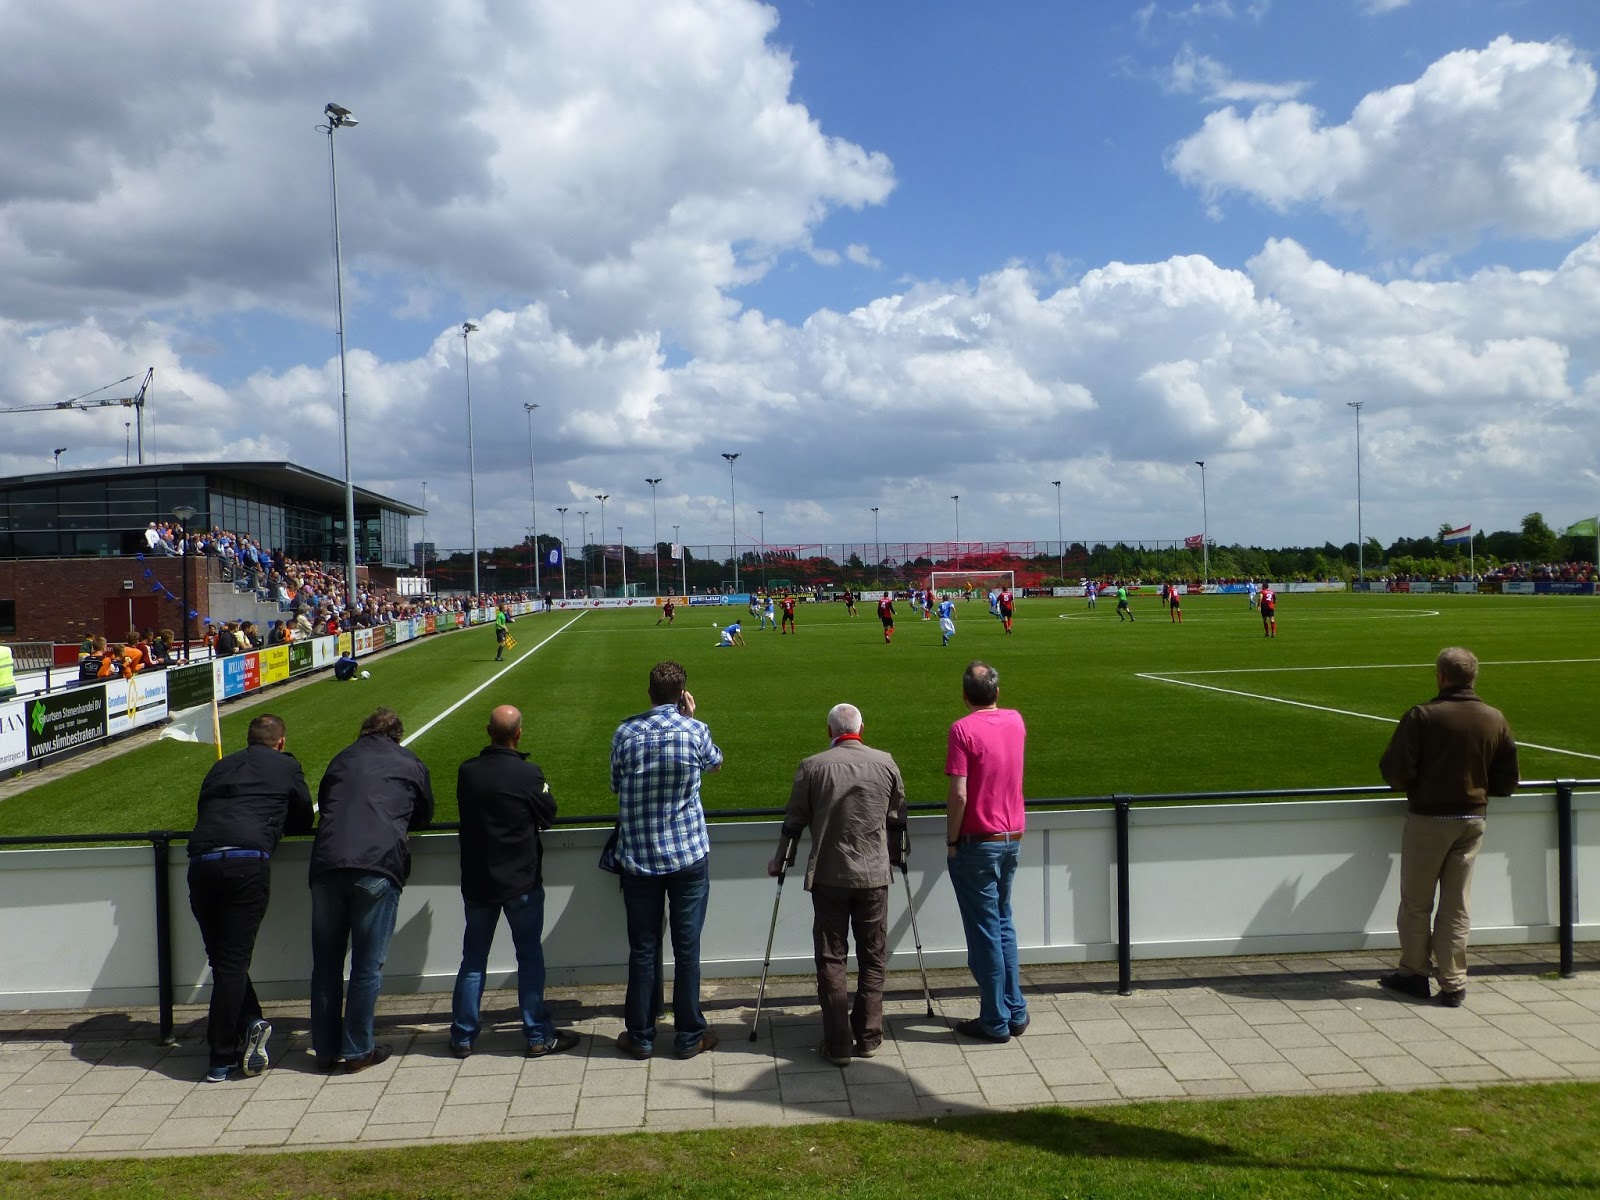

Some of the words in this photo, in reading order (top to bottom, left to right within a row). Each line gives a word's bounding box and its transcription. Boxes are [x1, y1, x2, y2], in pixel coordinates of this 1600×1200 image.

[933, 589, 977, 598] einekn
[1003, 594, 1009, 602] 5
[1266, 593, 1272, 601] 2
[228, 660, 244, 674] HOLLAND
[244, 658, 255, 670] SPORT
[38, 710, 62, 724] Geurtsen
[62, 700, 94, 718] Stenenhandel
[94, 699, 102, 710] BV
[31, 722, 103, 757] www.slimbestraten.nl
